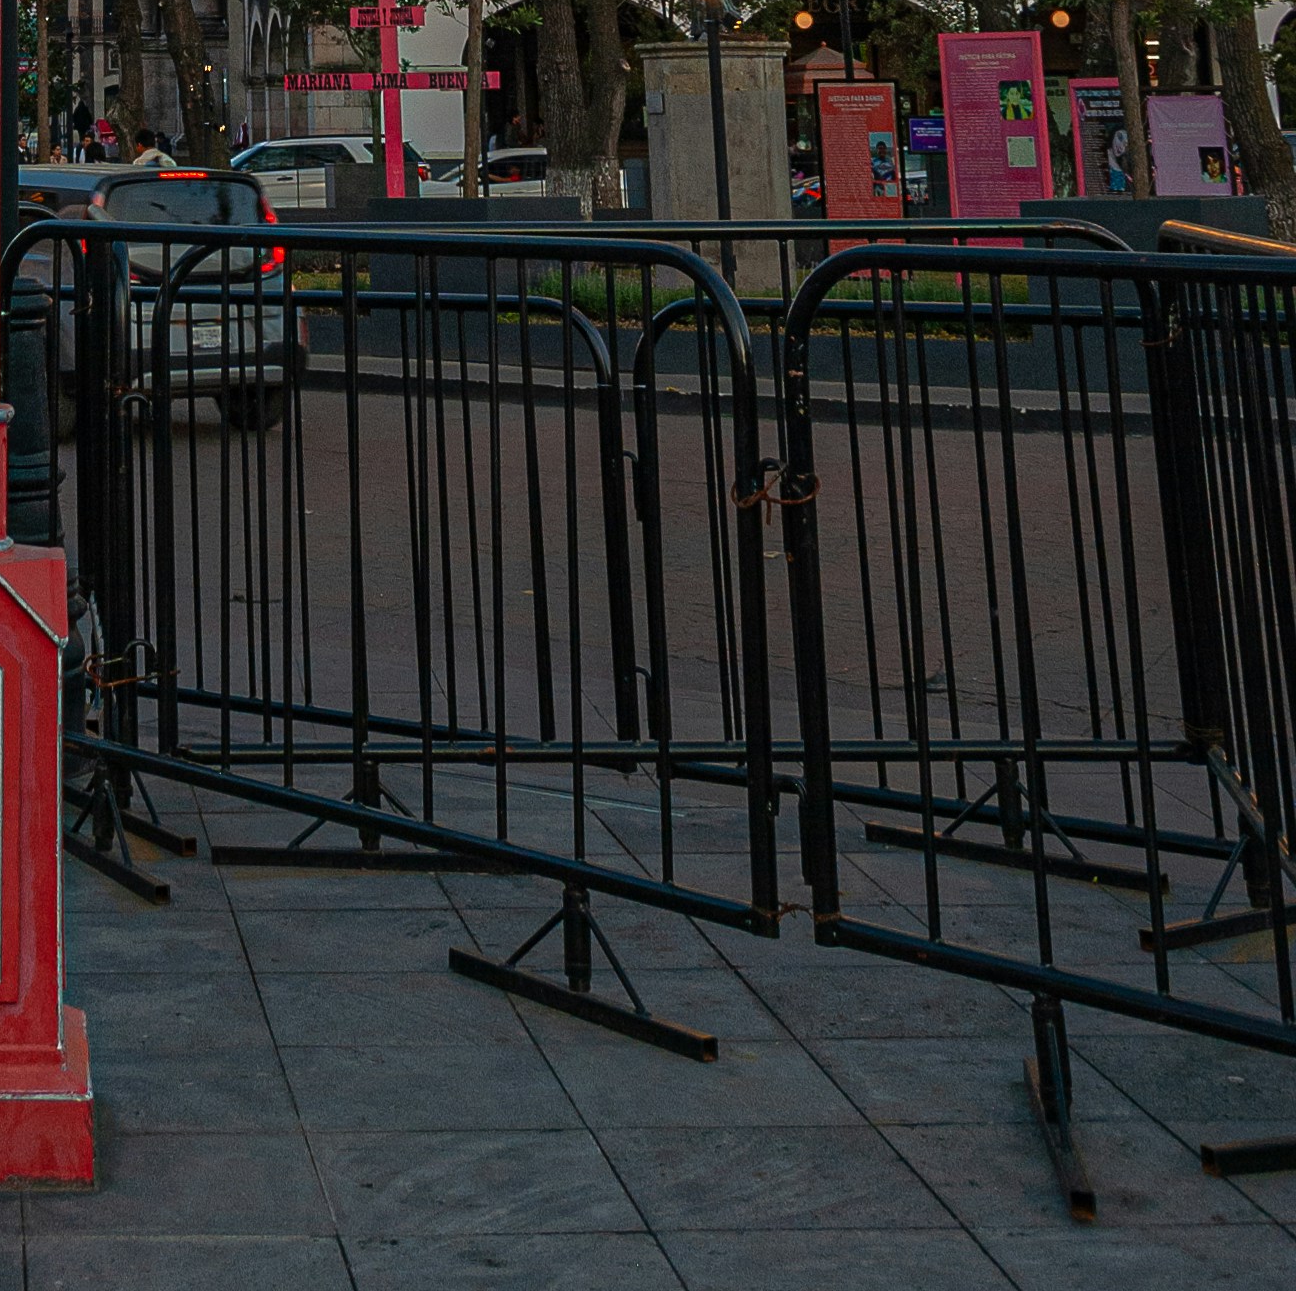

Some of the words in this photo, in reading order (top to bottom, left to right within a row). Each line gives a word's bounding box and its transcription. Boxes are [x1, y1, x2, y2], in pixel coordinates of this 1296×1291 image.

[287, 74, 352, 90] MARIANA
[372, 73, 408, 89] LIMA
[429, 72, 490, 90] BUENA
